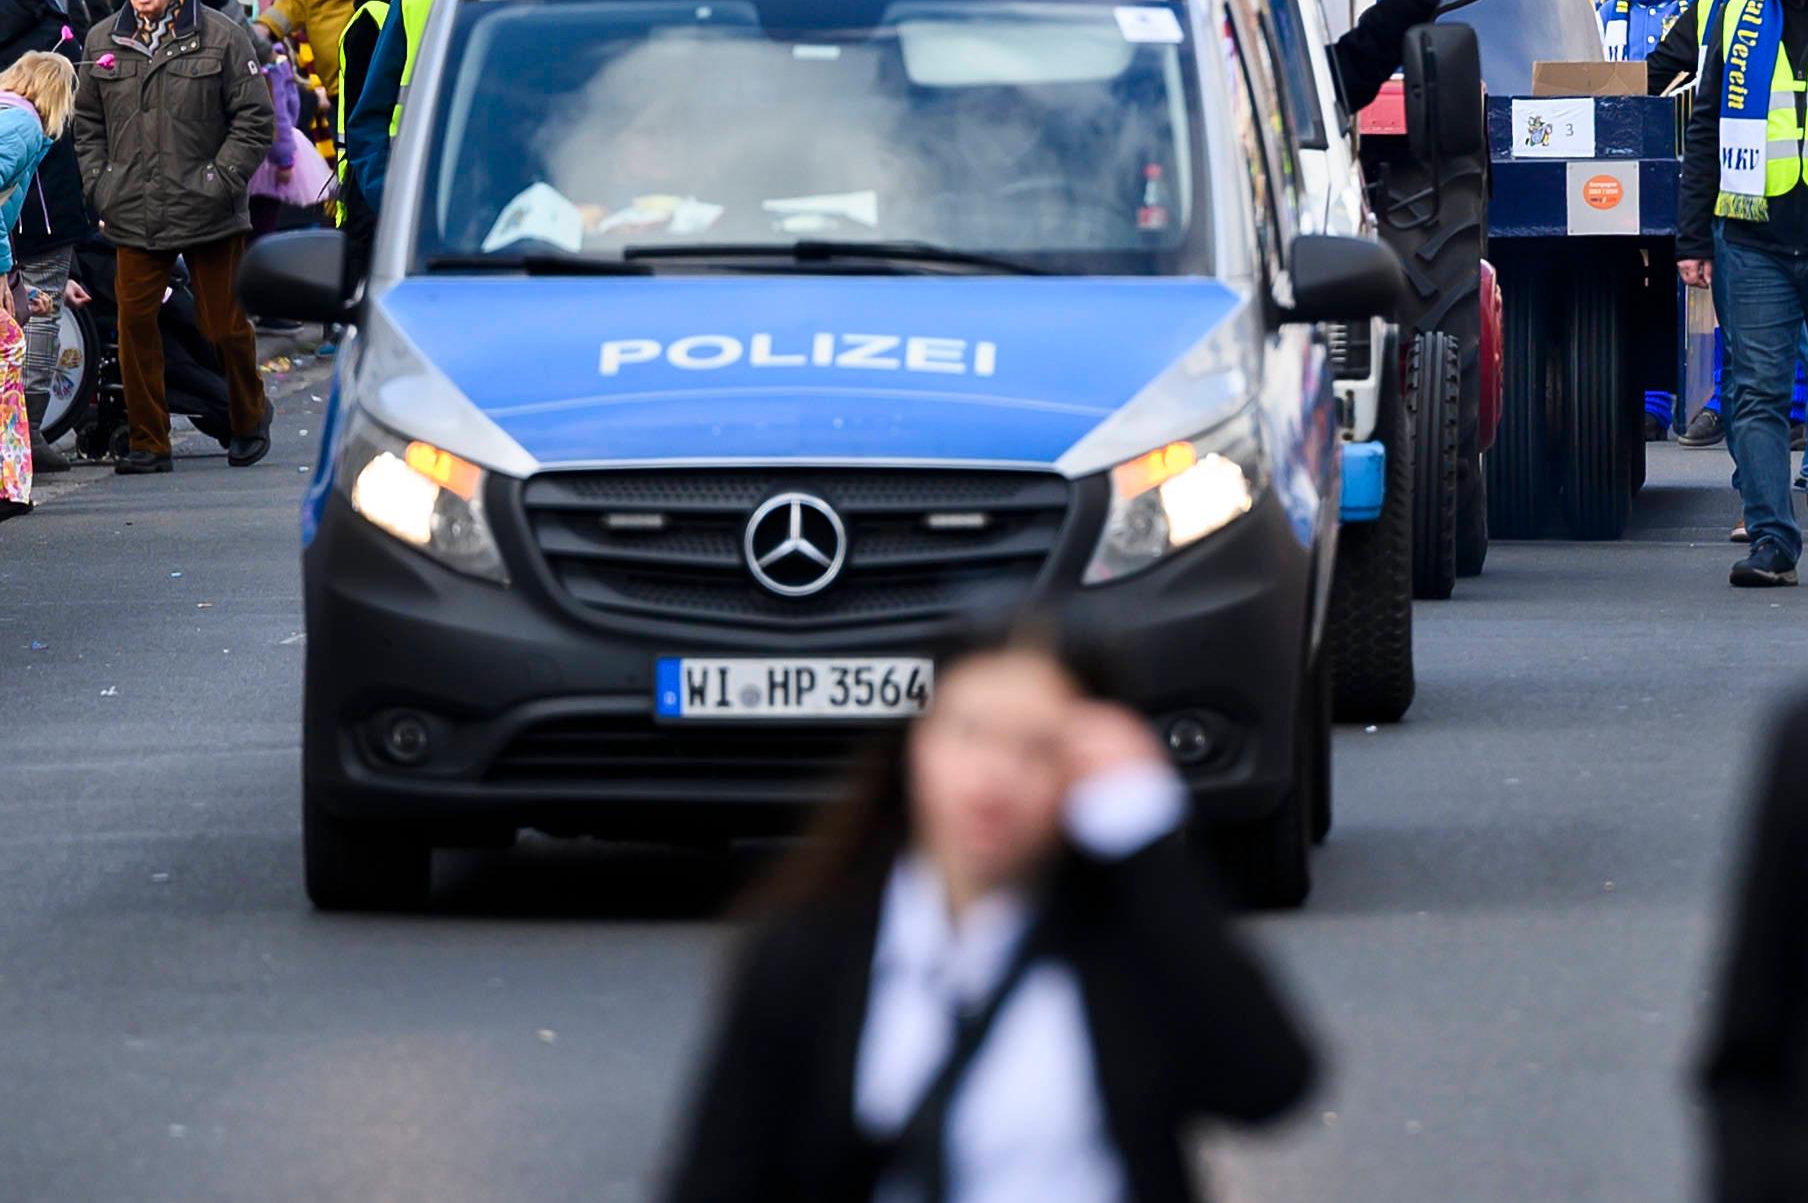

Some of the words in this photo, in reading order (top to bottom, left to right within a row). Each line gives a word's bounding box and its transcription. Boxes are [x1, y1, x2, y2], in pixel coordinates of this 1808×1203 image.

[1727, 28, 1760, 111] Verein
[1565, 123, 1575, 137] 3
[1722, 147, 1760, 171] MKV
[599, 331, 997, 378] POLIZEI
[686, 666, 731, 708] WI
[767, 666, 817, 707] HP
[829, 665, 929, 710] 3564
